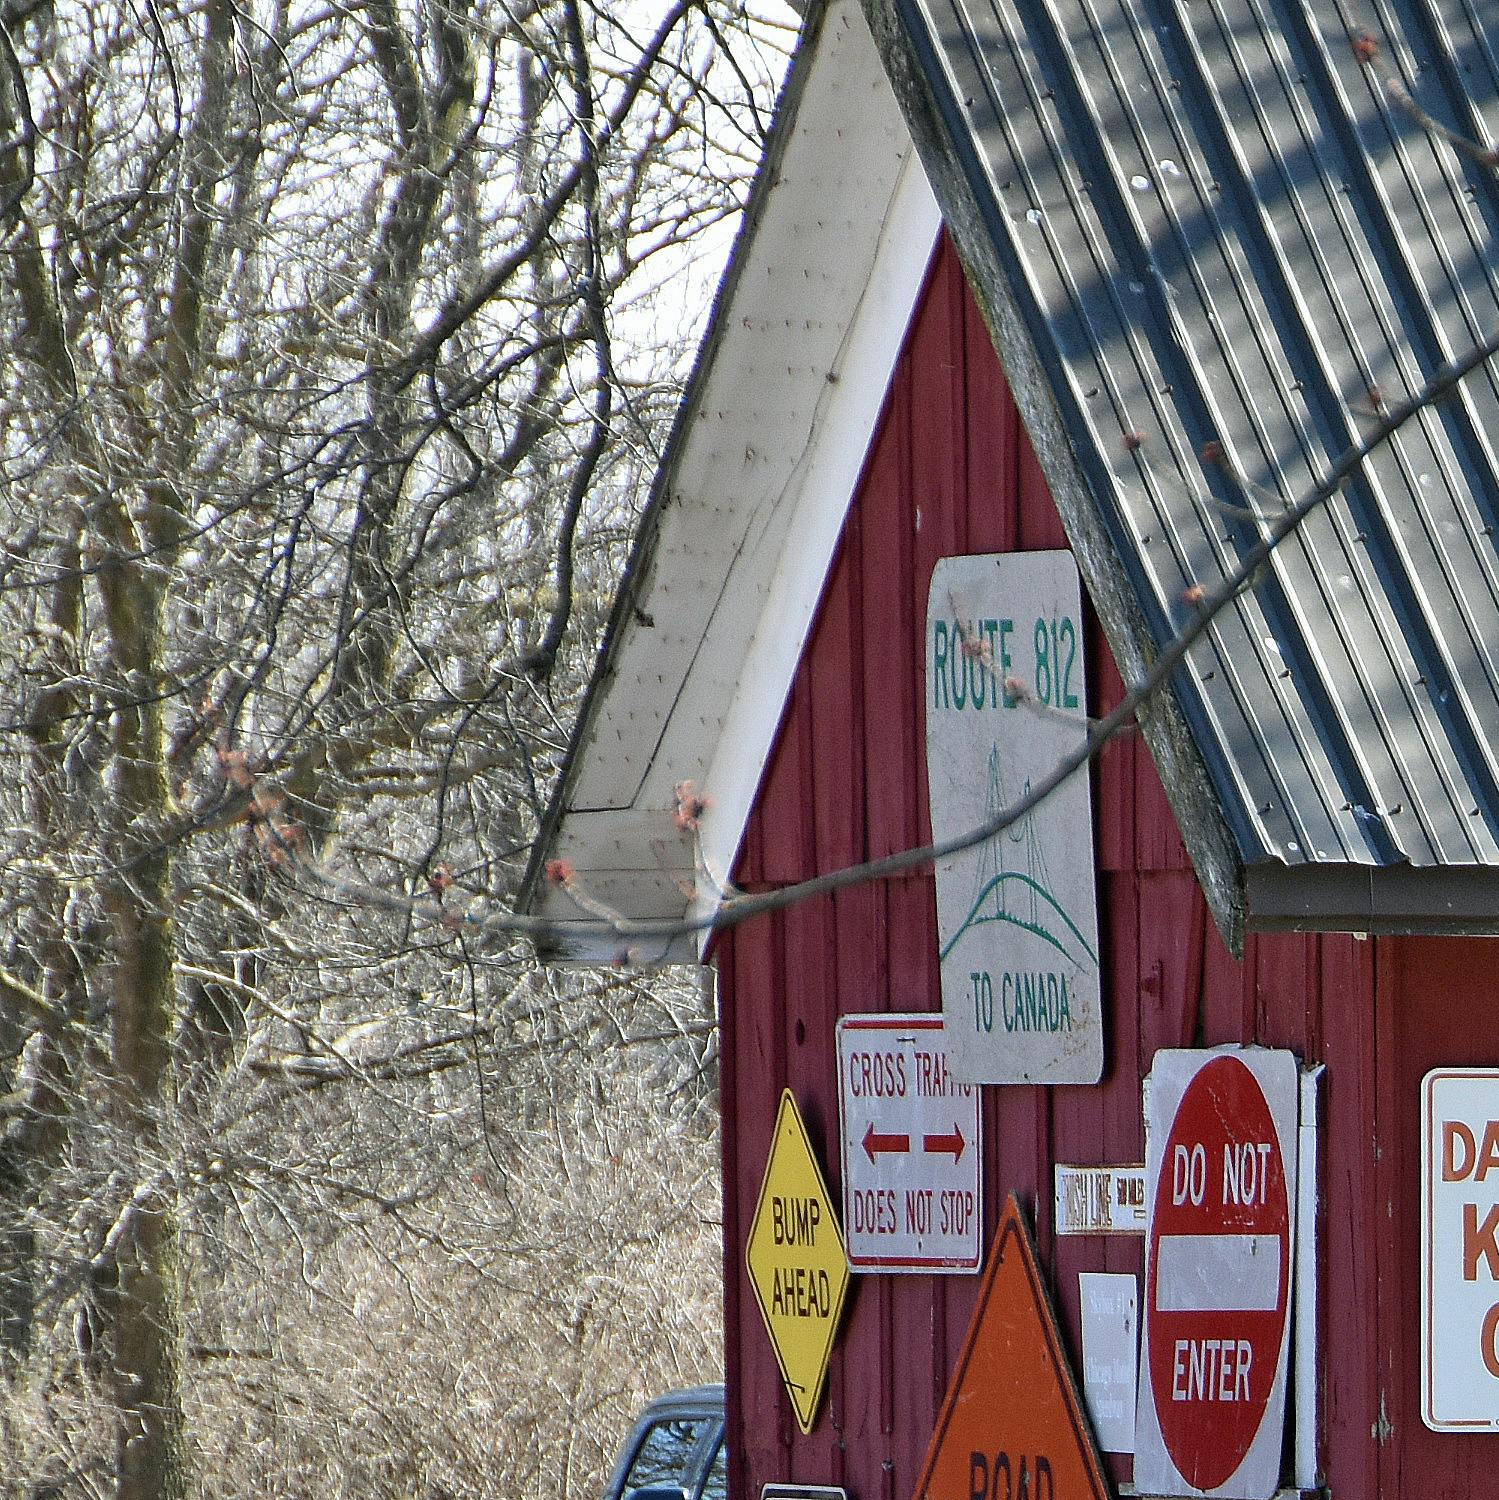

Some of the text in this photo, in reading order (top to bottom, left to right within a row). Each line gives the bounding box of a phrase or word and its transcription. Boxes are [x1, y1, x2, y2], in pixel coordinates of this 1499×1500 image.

[934, 616, 1078, 709] ROUTE 812
[971, 972, 1072, 1033] TO CANADA
[850, 1052, 971, 1097] CROSS TRAF
[1173, 1143, 1271, 1205] DO NOT
[773, 1197, 819, 1247] BUMP
[855, 1189, 973, 1235] DOES NOT STOP
[772, 1269, 830, 1319] AHEAD
[1172, 1339, 1253, 1401] ENTER
